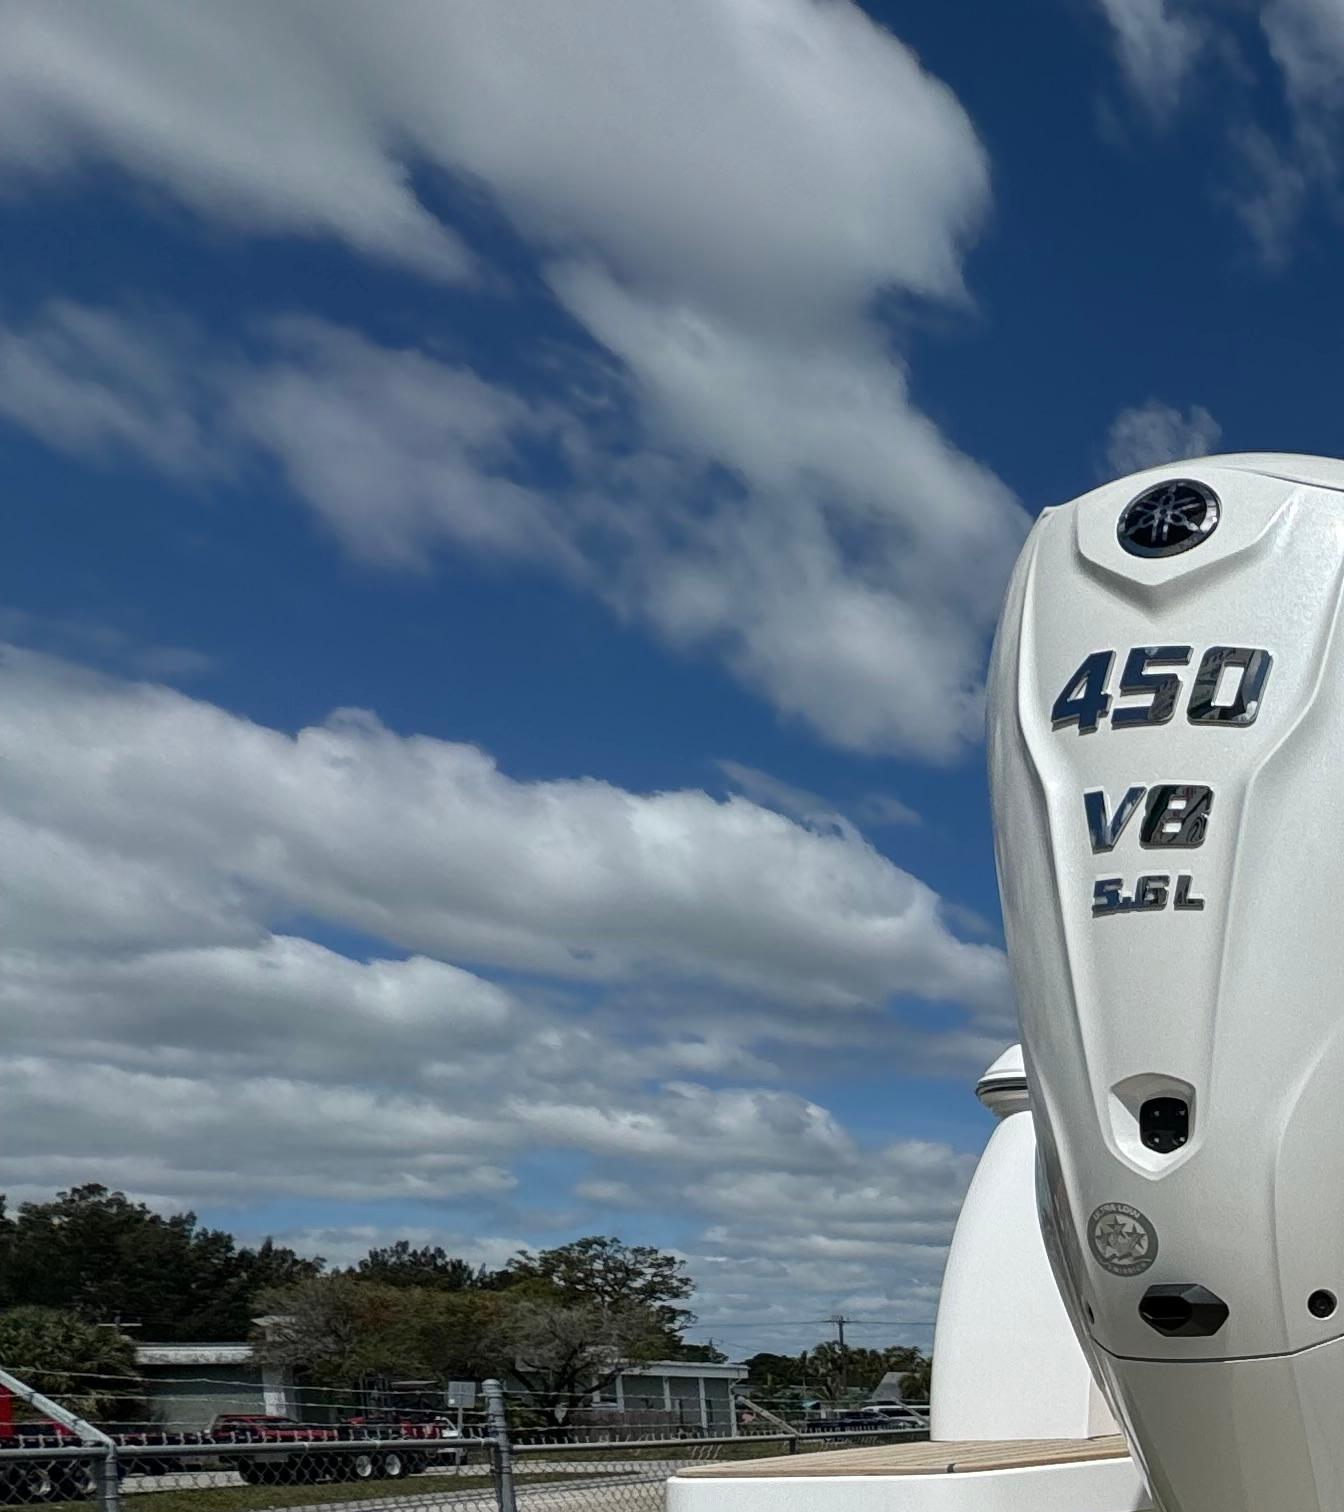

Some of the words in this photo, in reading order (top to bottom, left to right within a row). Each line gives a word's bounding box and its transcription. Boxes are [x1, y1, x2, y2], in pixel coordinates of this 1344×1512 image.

[1051, 645, 1273, 735] 450
[1083, 784, 1214, 854] V8
[1091, 874, 1205, 919] 5.6L
